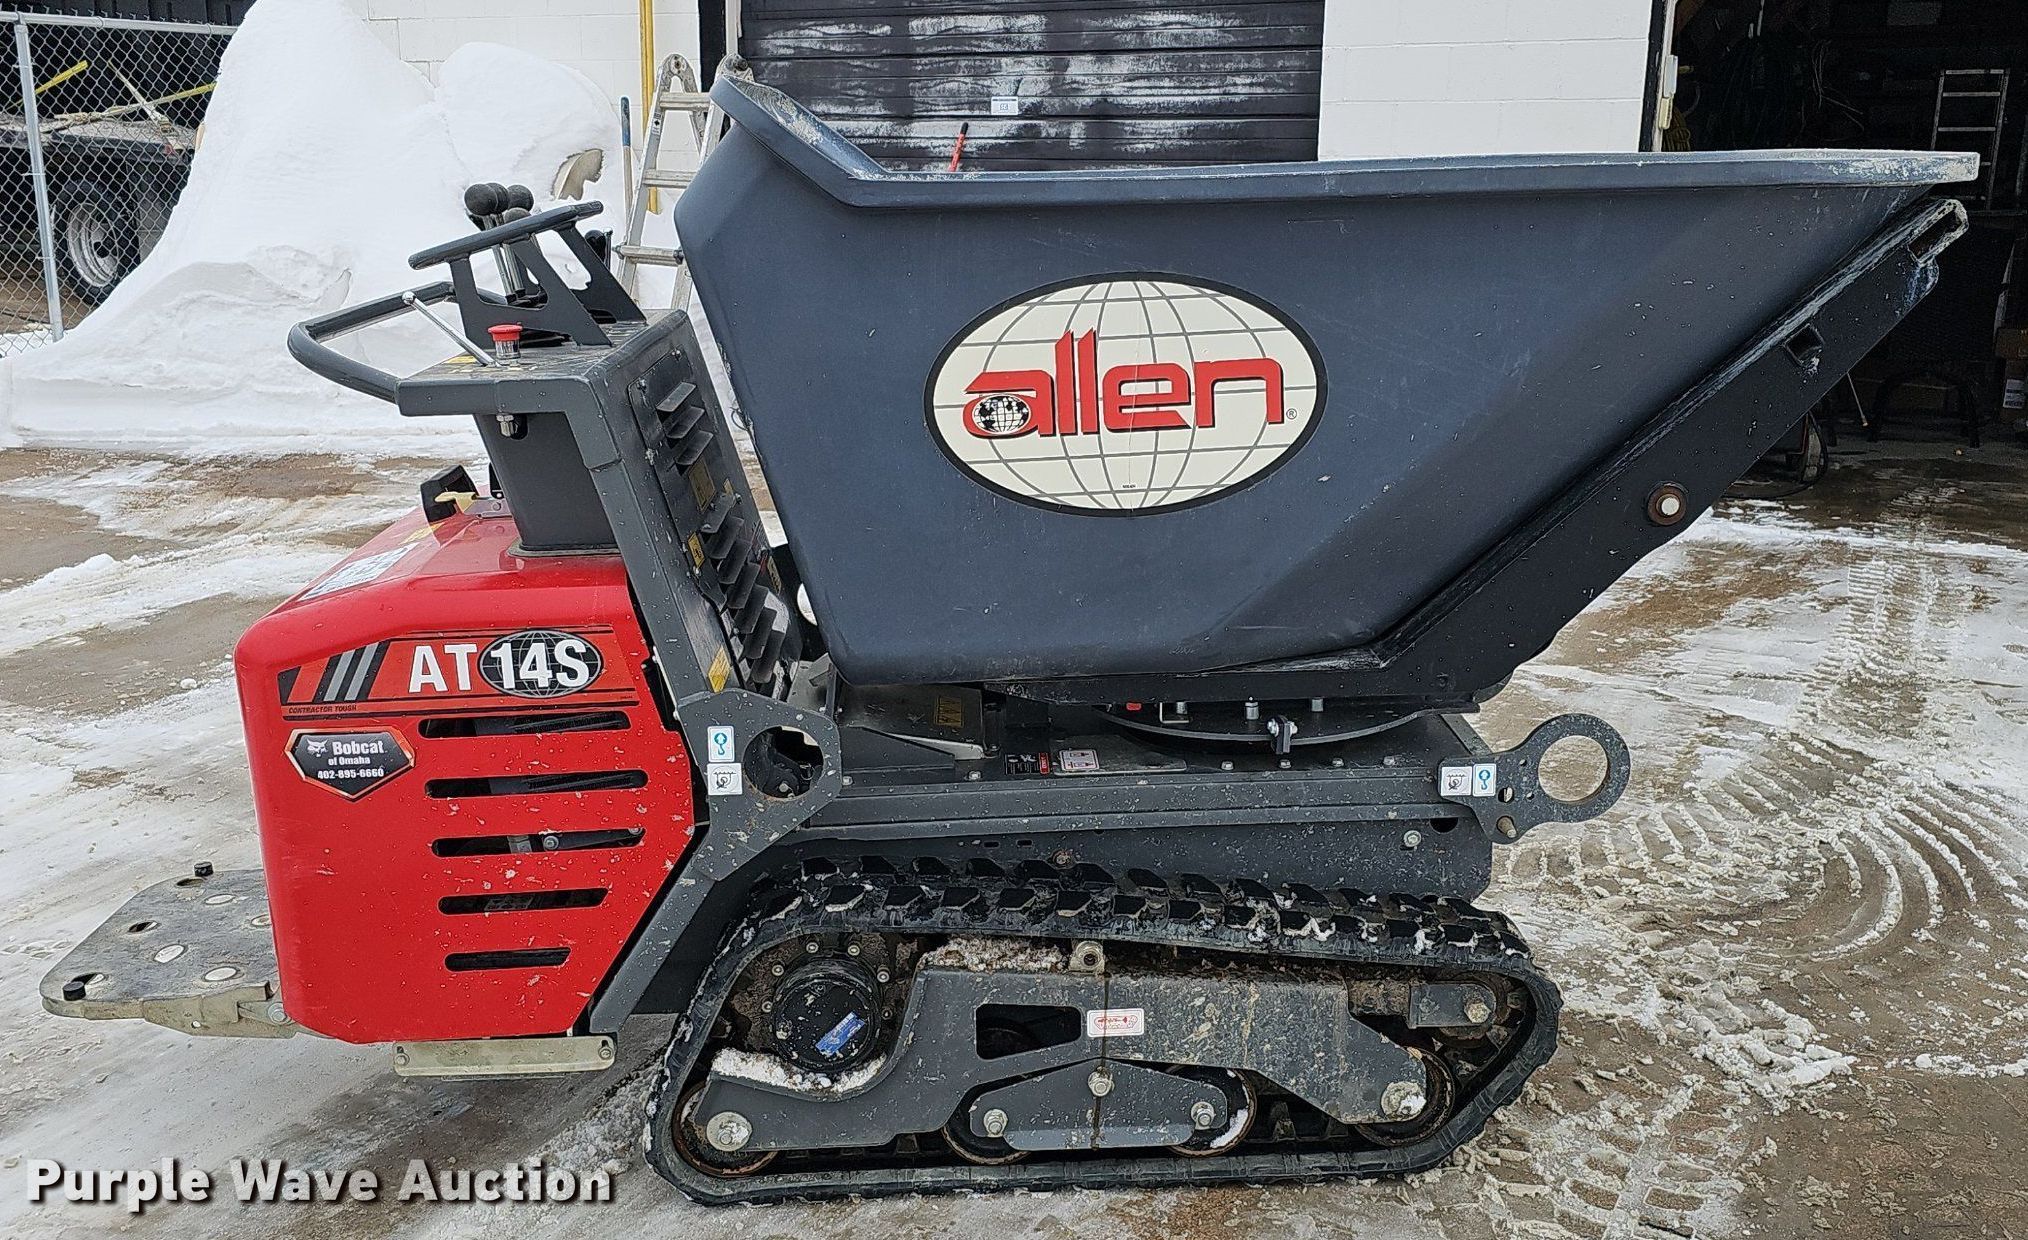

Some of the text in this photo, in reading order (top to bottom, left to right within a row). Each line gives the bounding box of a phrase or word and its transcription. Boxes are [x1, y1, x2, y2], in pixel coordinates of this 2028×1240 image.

[963, 328, 1284, 438] allen
[408, 639, 590, 693] AT 14S
[289, 706, 332, 714] CONTRACTOR
[332, 740, 384, 755] Bobcat
[328, 757, 370, 766] of Omaha
[317, 768, 384, 779] 402-895-6660
